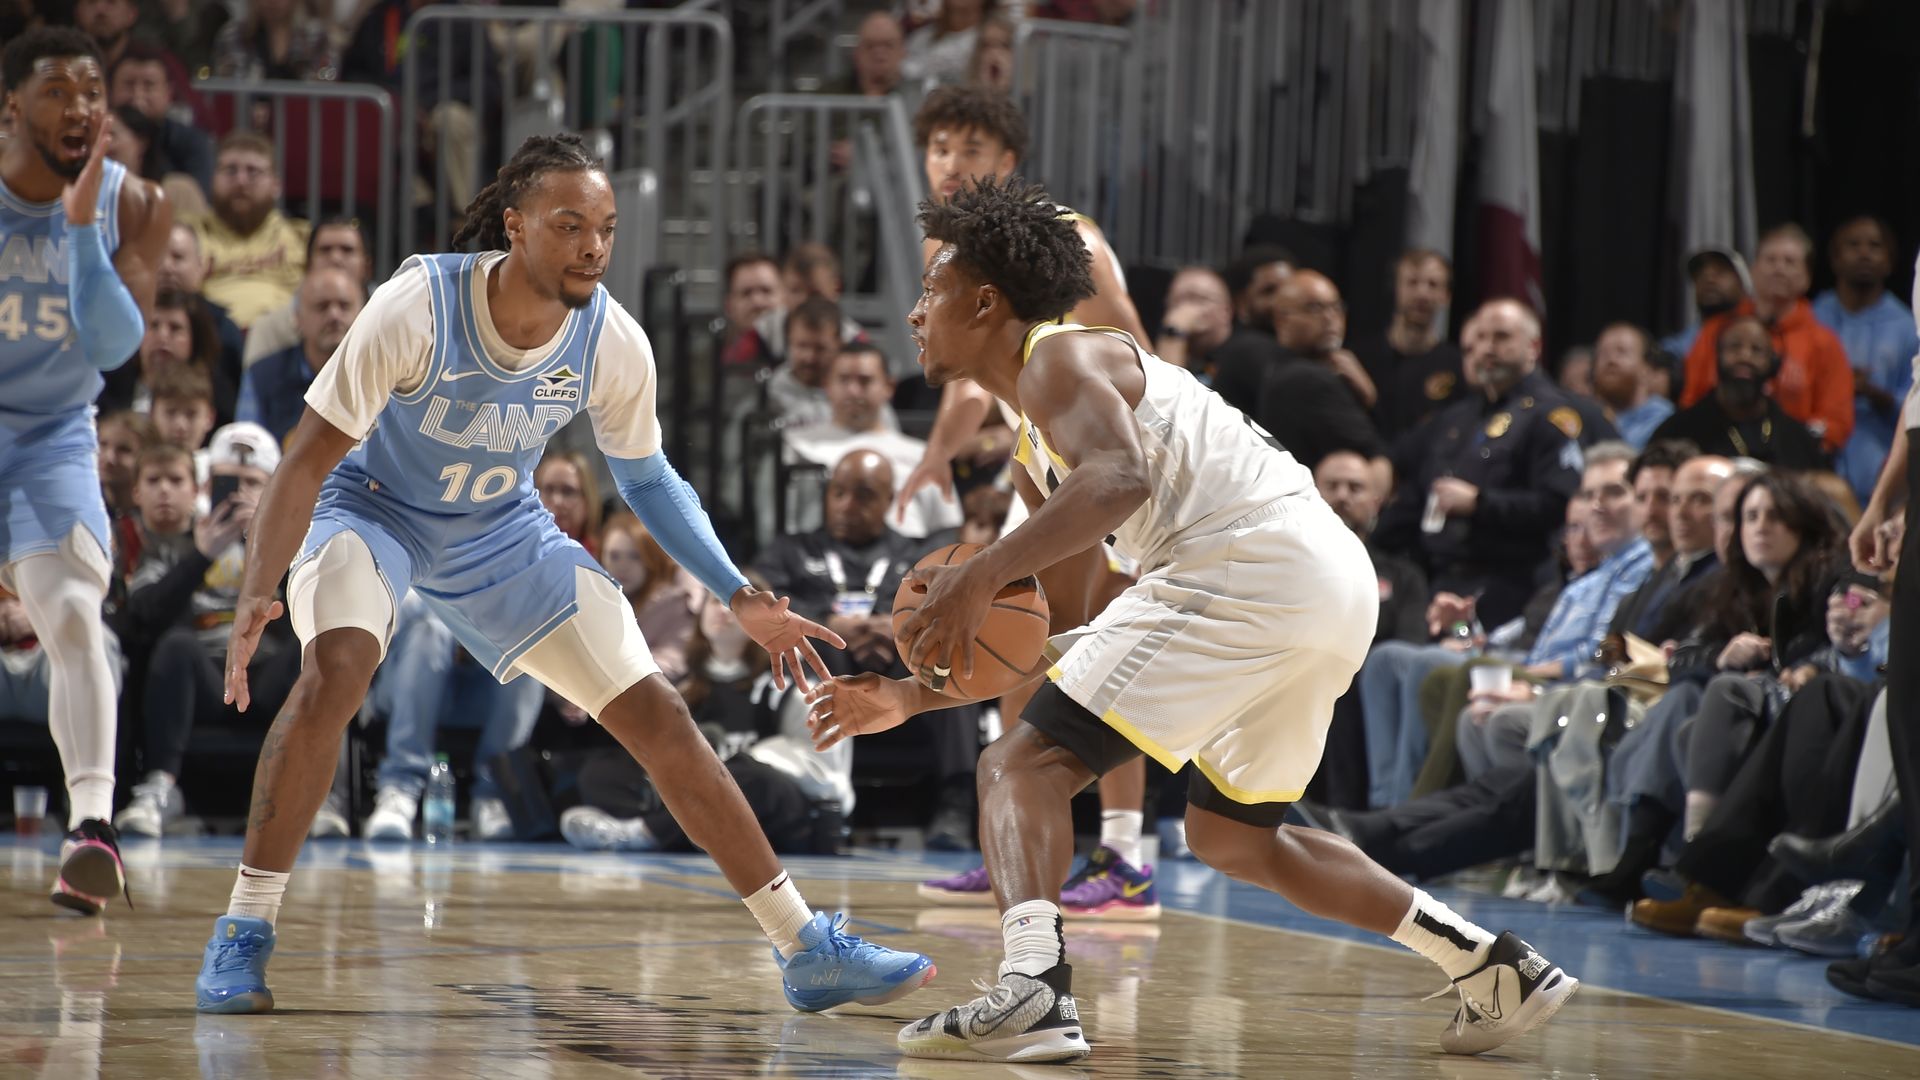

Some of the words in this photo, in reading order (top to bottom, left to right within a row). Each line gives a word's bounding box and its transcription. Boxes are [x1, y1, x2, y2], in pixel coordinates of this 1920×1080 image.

[0, 294, 68, 342] 45
[455, 400, 477, 412] THE
[534, 388, 577, 399] CLIFFS
[418, 395, 573, 453] LAND
[439, 462, 517, 503] 10
